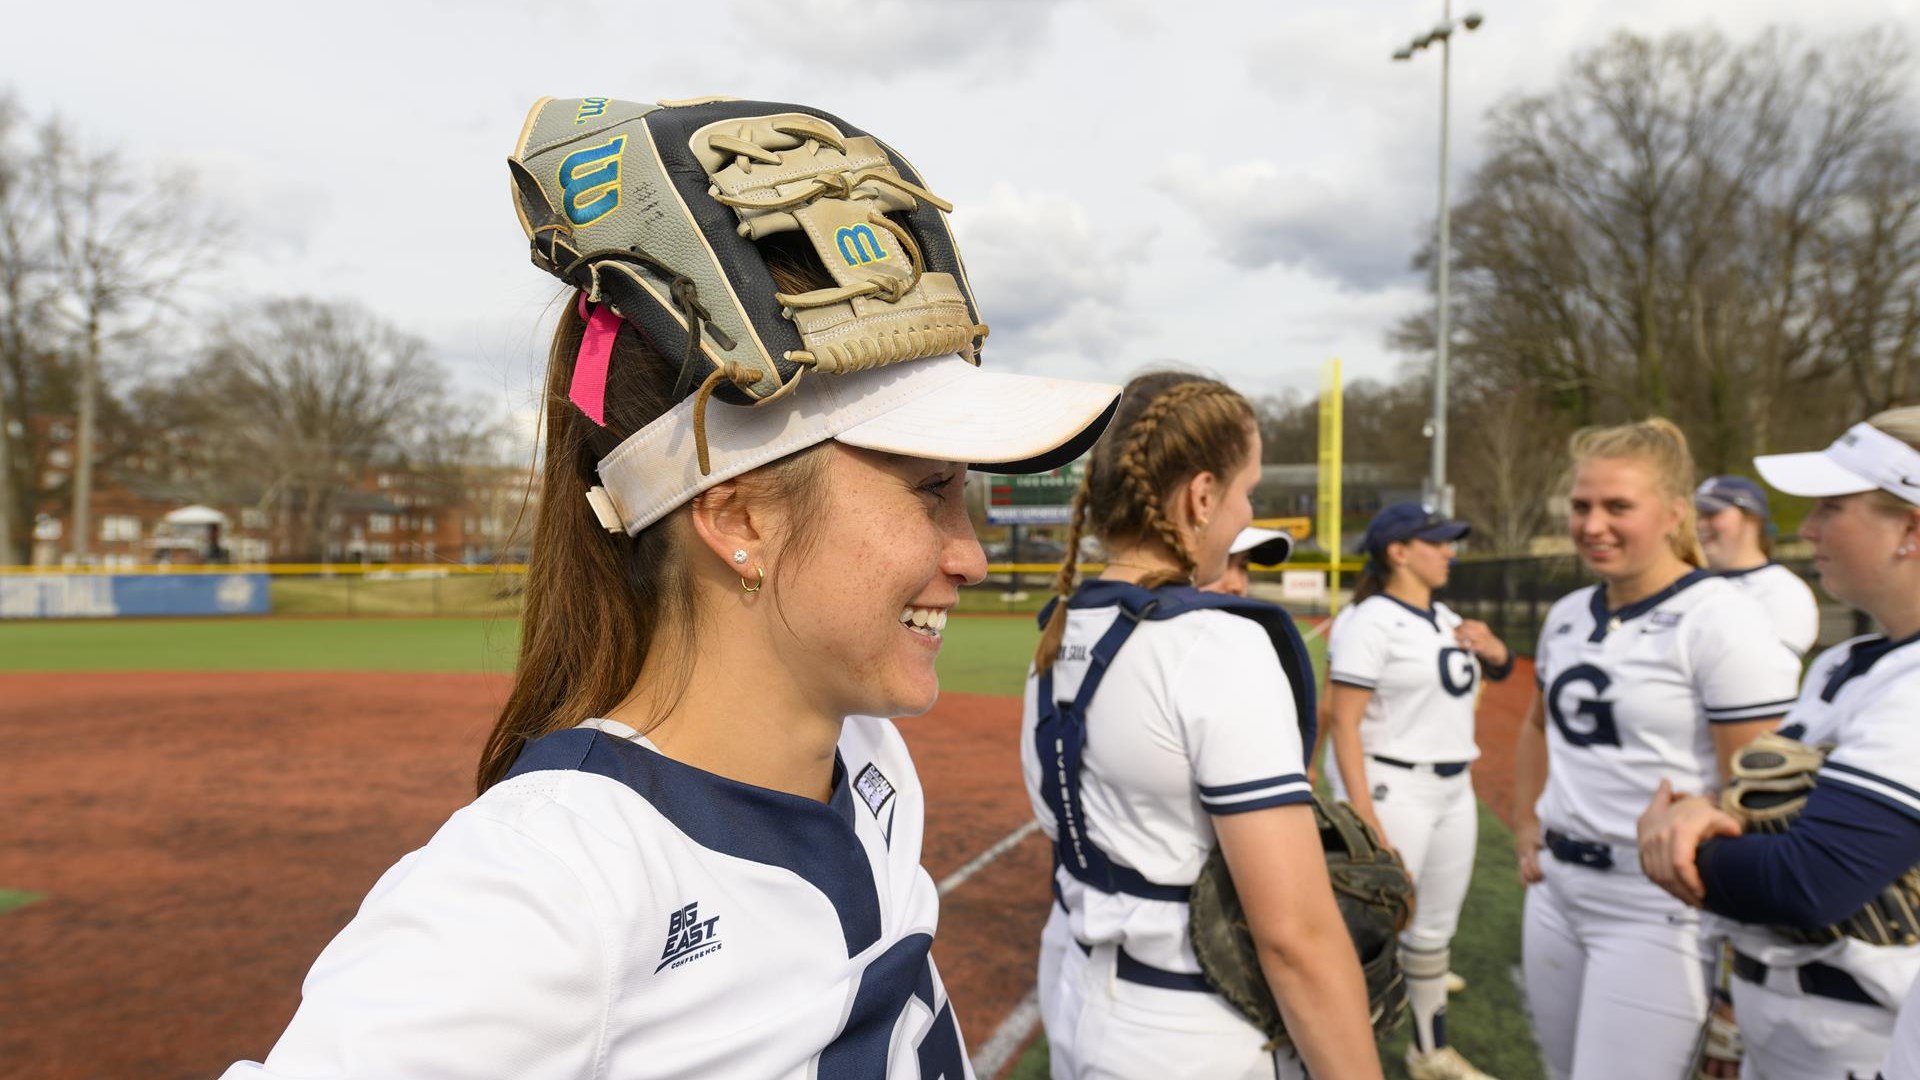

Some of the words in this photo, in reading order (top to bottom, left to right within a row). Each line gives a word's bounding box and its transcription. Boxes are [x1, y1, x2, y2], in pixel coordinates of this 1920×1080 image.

[1438, 647, 1474, 697] G
[1548, 663, 1622, 749] G
[661, 915, 720, 960] EAST
[667, 900, 699, 937] BIG
[671, 942, 723, 969] CONFERENCE
